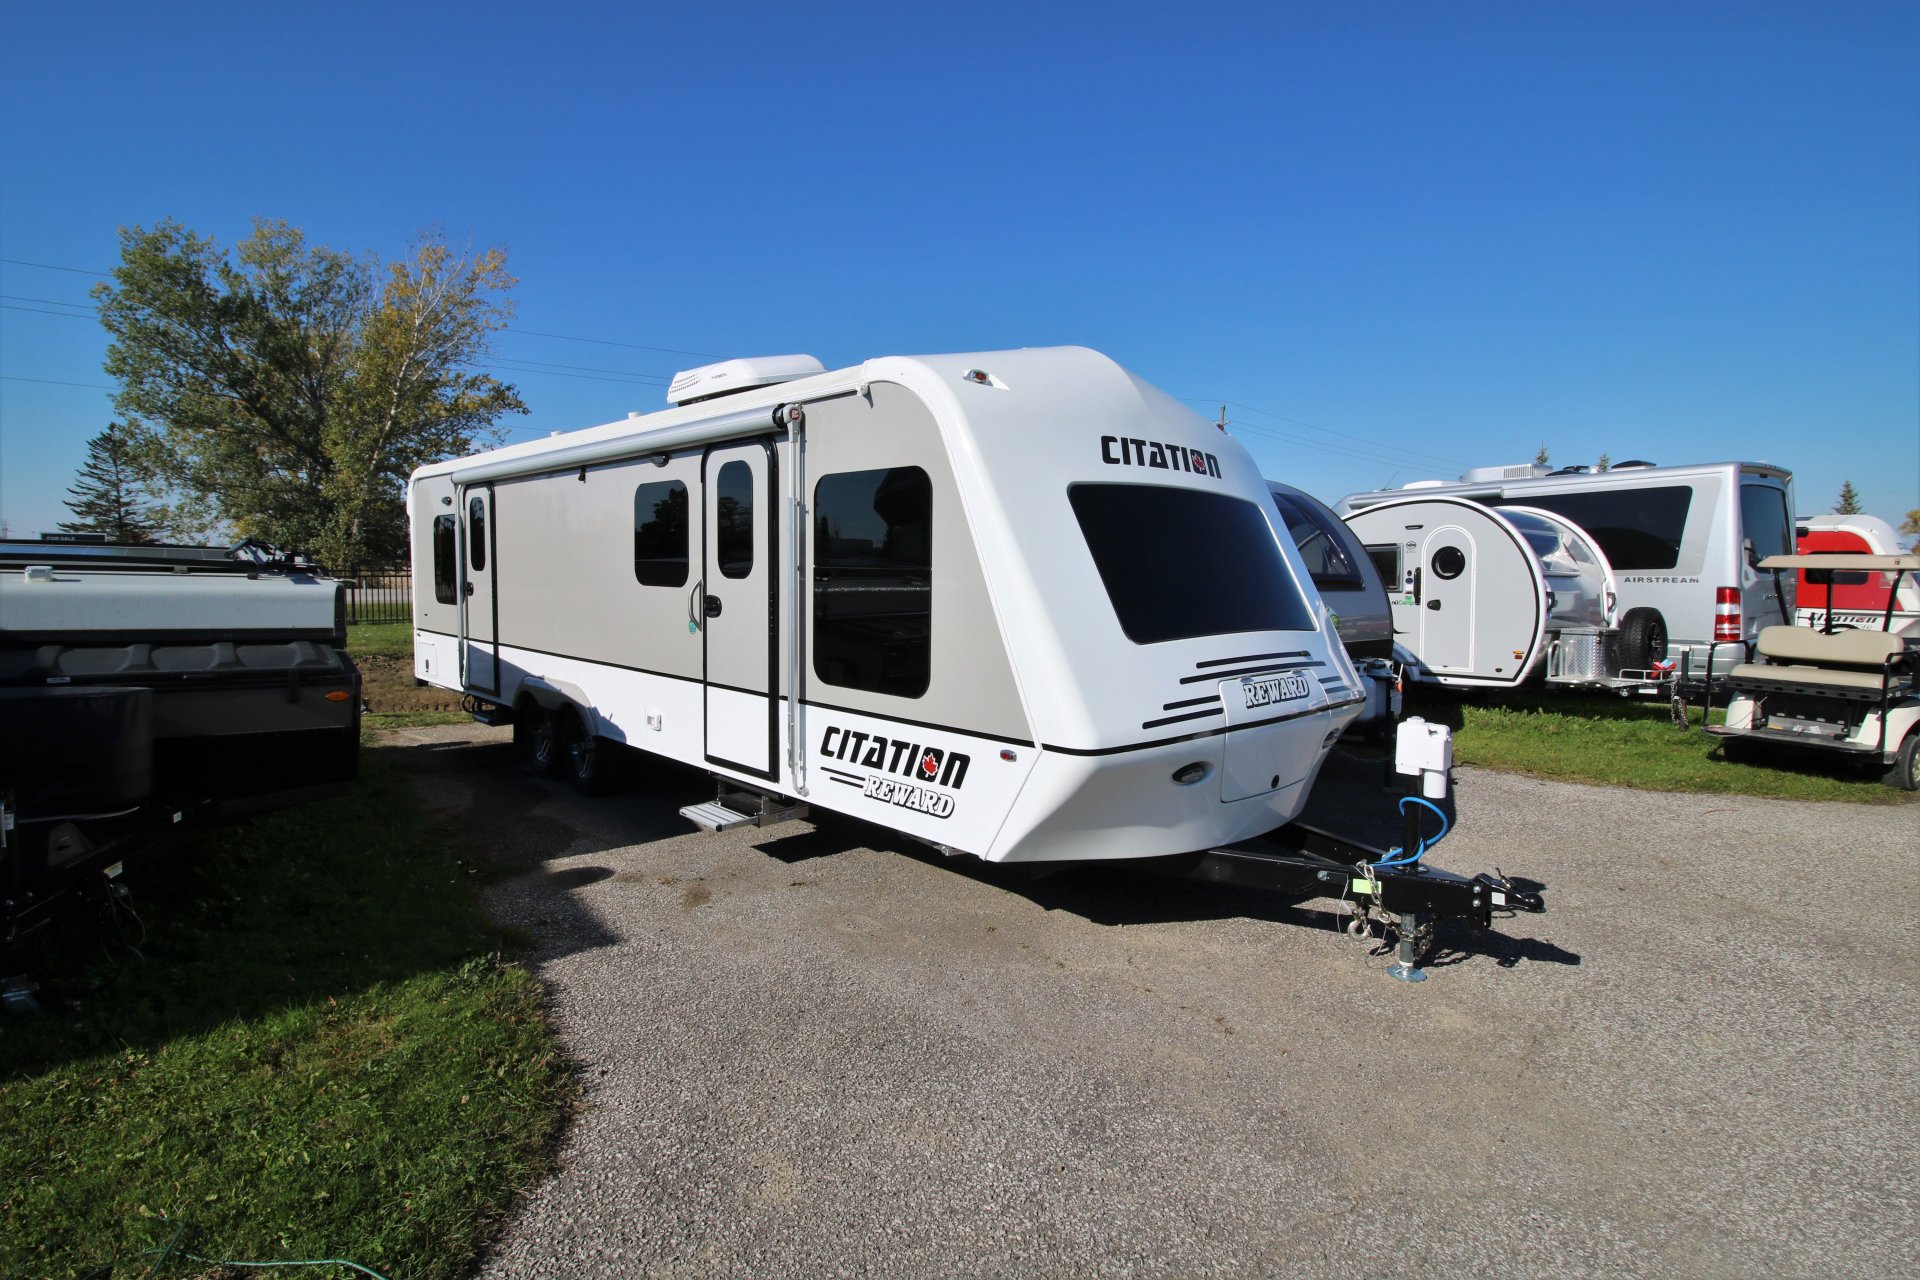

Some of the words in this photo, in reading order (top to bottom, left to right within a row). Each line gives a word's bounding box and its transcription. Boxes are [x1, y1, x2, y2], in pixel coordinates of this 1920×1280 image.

[1100, 435, 1222, 480] CITATION
[1623, 576, 1699, 584] AIRSTREAM
[1242, 676, 1310, 709] REWARD
[820, 725, 971, 790] CITATION
[863, 775, 956, 820] REWARD
